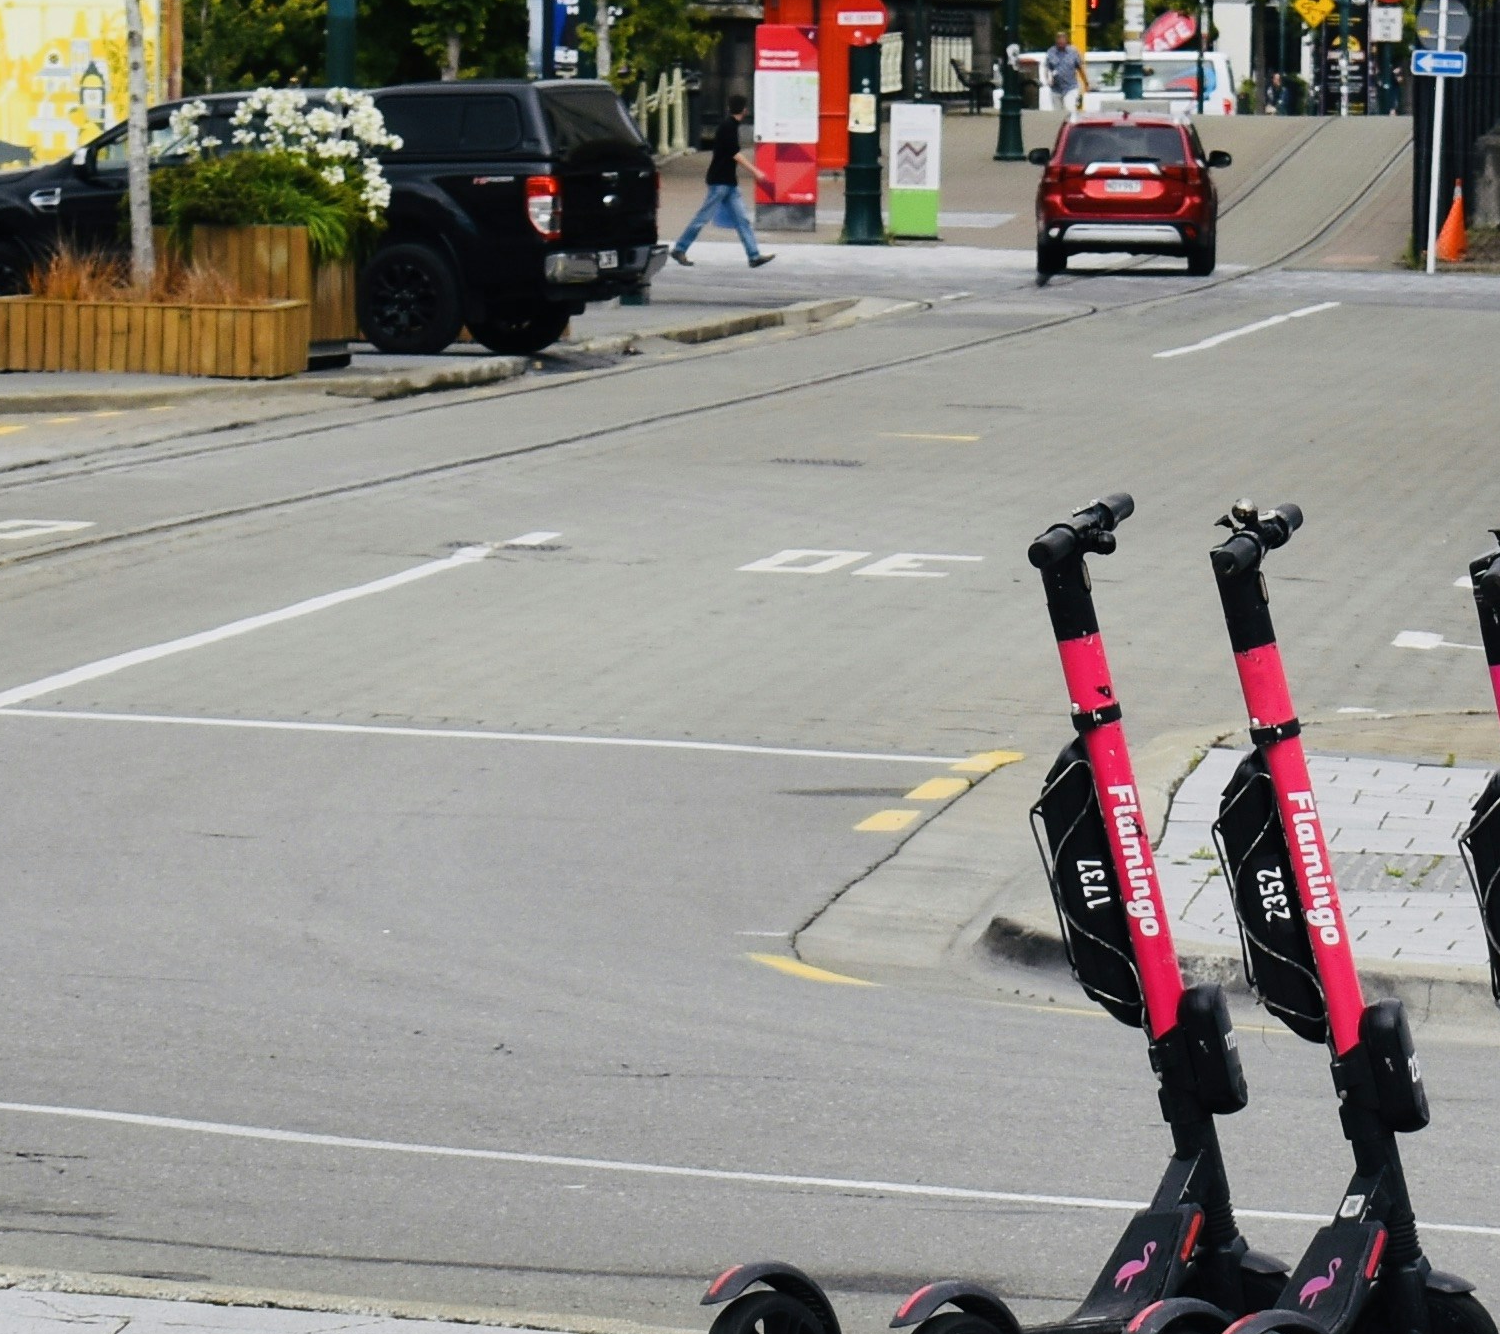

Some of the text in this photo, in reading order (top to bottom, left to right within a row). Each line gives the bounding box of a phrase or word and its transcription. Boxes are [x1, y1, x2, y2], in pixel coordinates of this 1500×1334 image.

[1076, 859, 1111, 909] 1737
[1107, 784, 1161, 937] Flamingo
[1256, 866, 1291, 923] 2352
[1287, 790, 1340, 945] Flamingo
